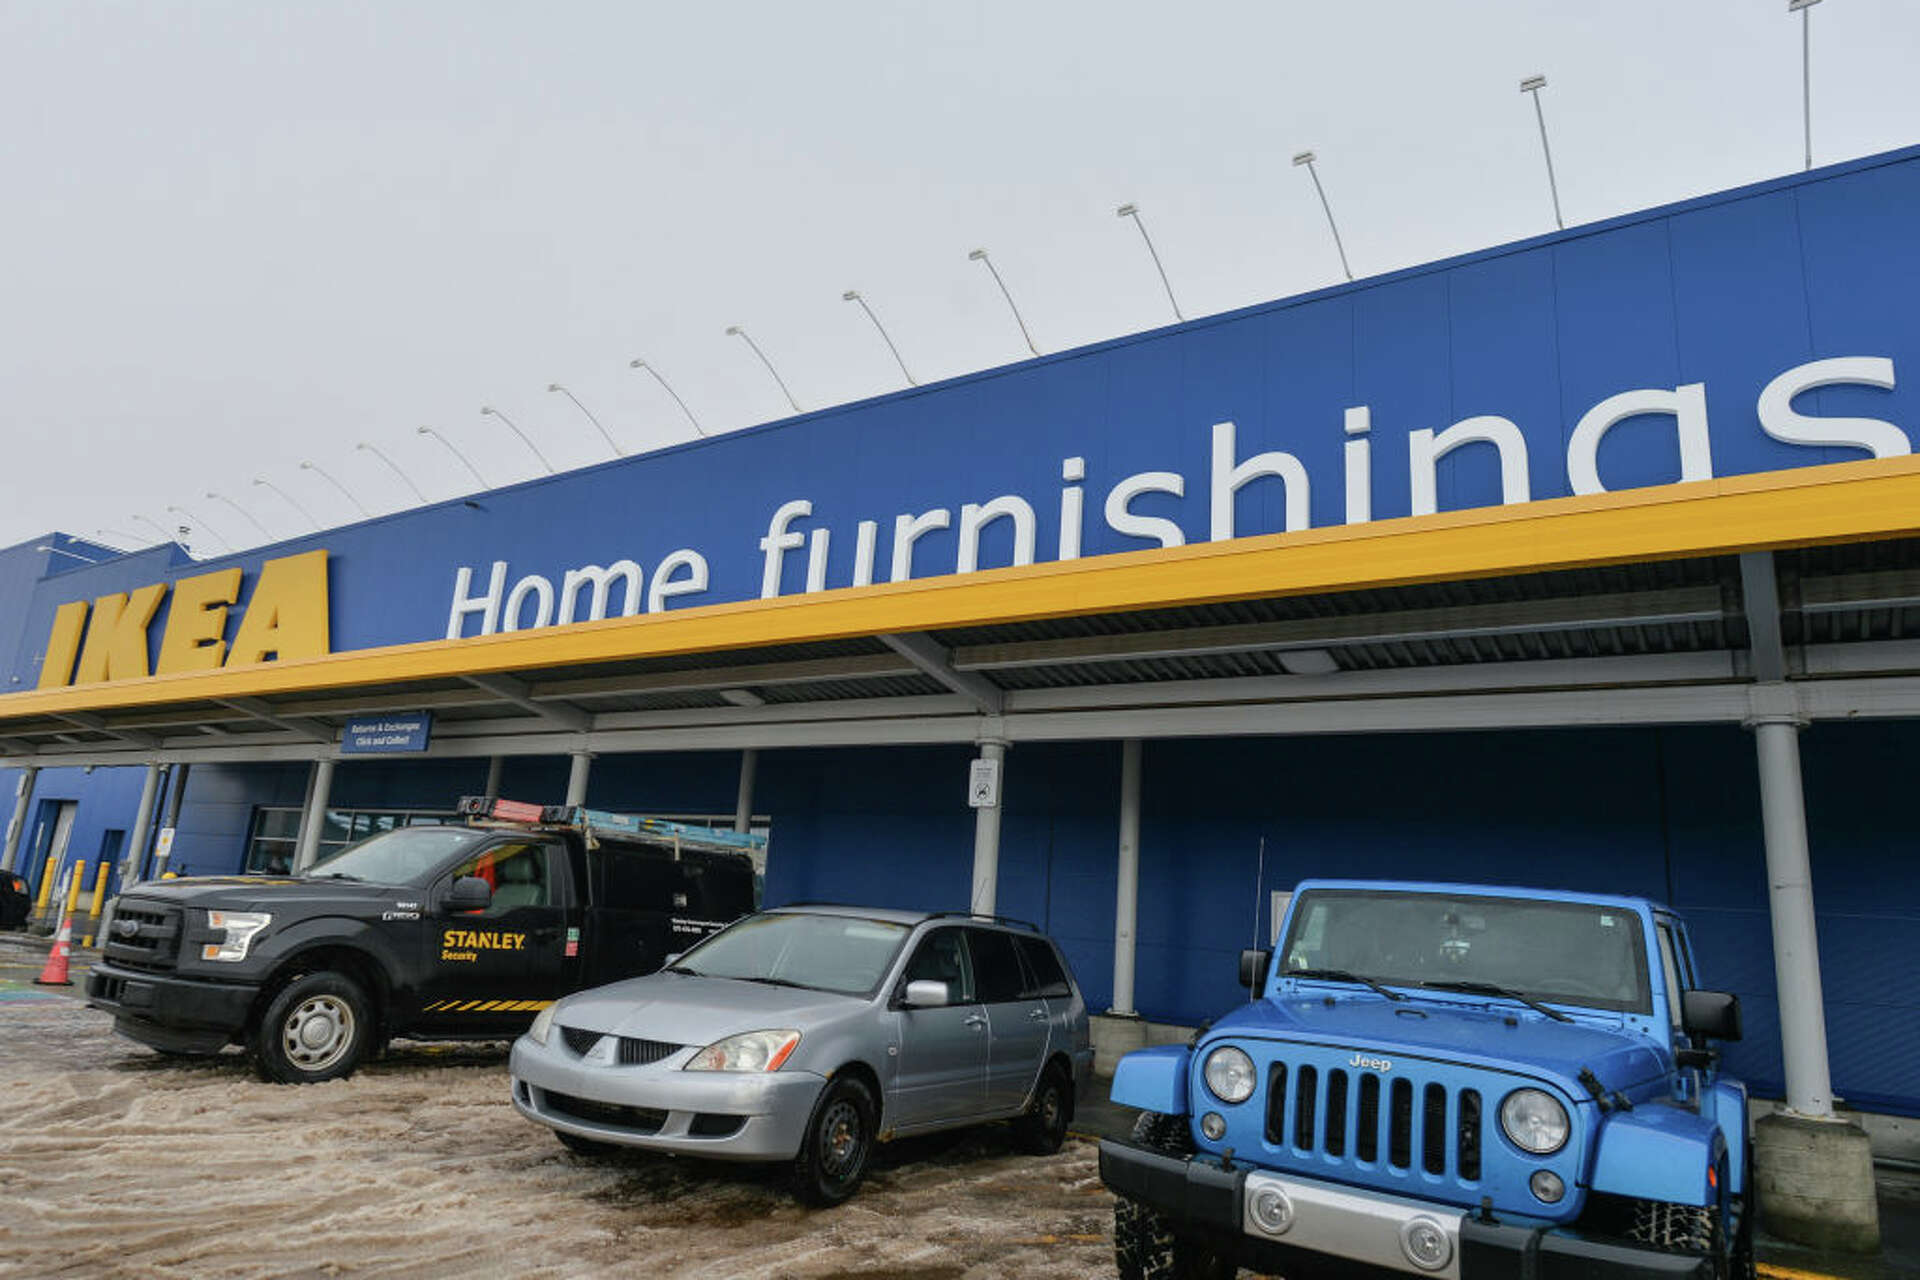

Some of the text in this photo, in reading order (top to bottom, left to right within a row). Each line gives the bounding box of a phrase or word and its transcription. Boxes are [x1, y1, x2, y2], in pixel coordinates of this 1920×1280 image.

[446, 549, 710, 639] Home
[36, 549, 331, 690] IKEA
[442, 930, 525, 950] STANLEY
[441, 949, 478, 963] Security
[1349, 1054, 1393, 1073] Jeep
